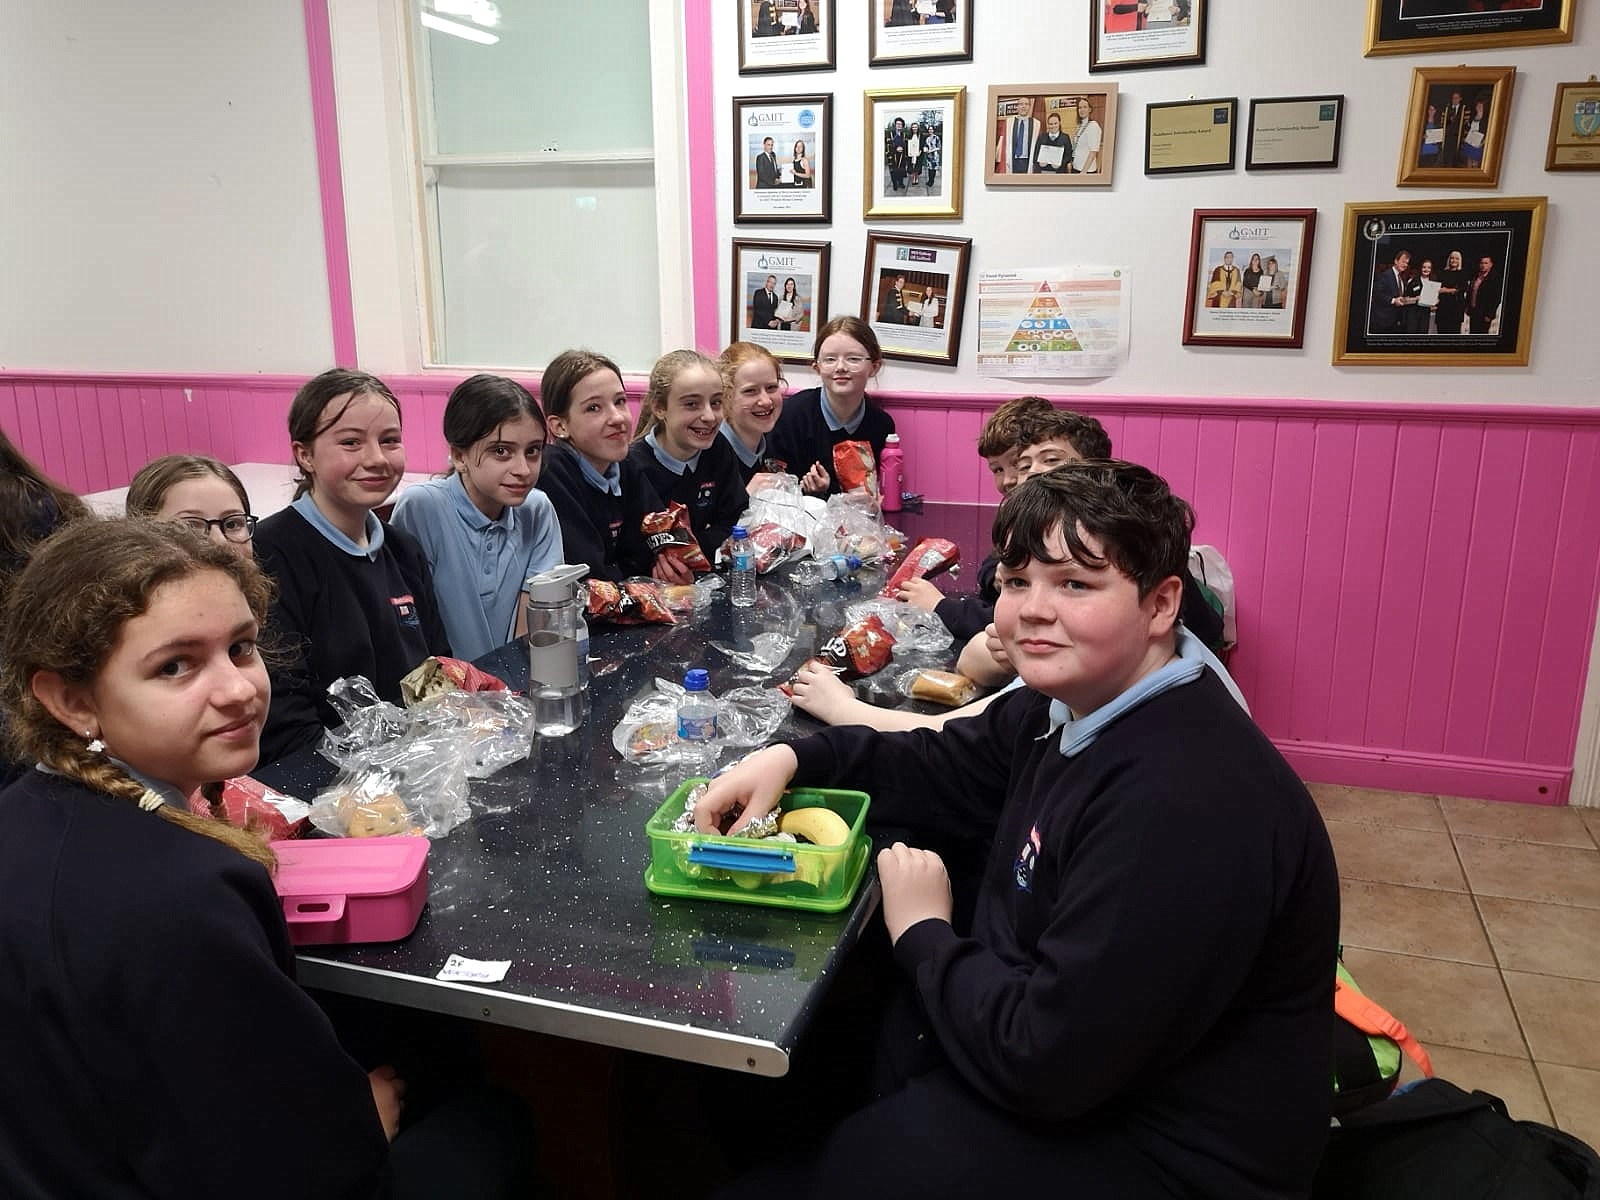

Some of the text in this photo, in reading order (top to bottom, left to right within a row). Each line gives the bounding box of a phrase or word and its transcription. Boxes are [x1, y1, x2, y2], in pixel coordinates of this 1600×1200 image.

[759, 112, 784, 121] GMIT
[1403, 222, 1436, 230] IRELAND
[1437, 221, 1491, 229] SCHOLARSHIPS
[1240, 227, 1270, 236] GMIT
[768, 256, 797, 266] GMIT
